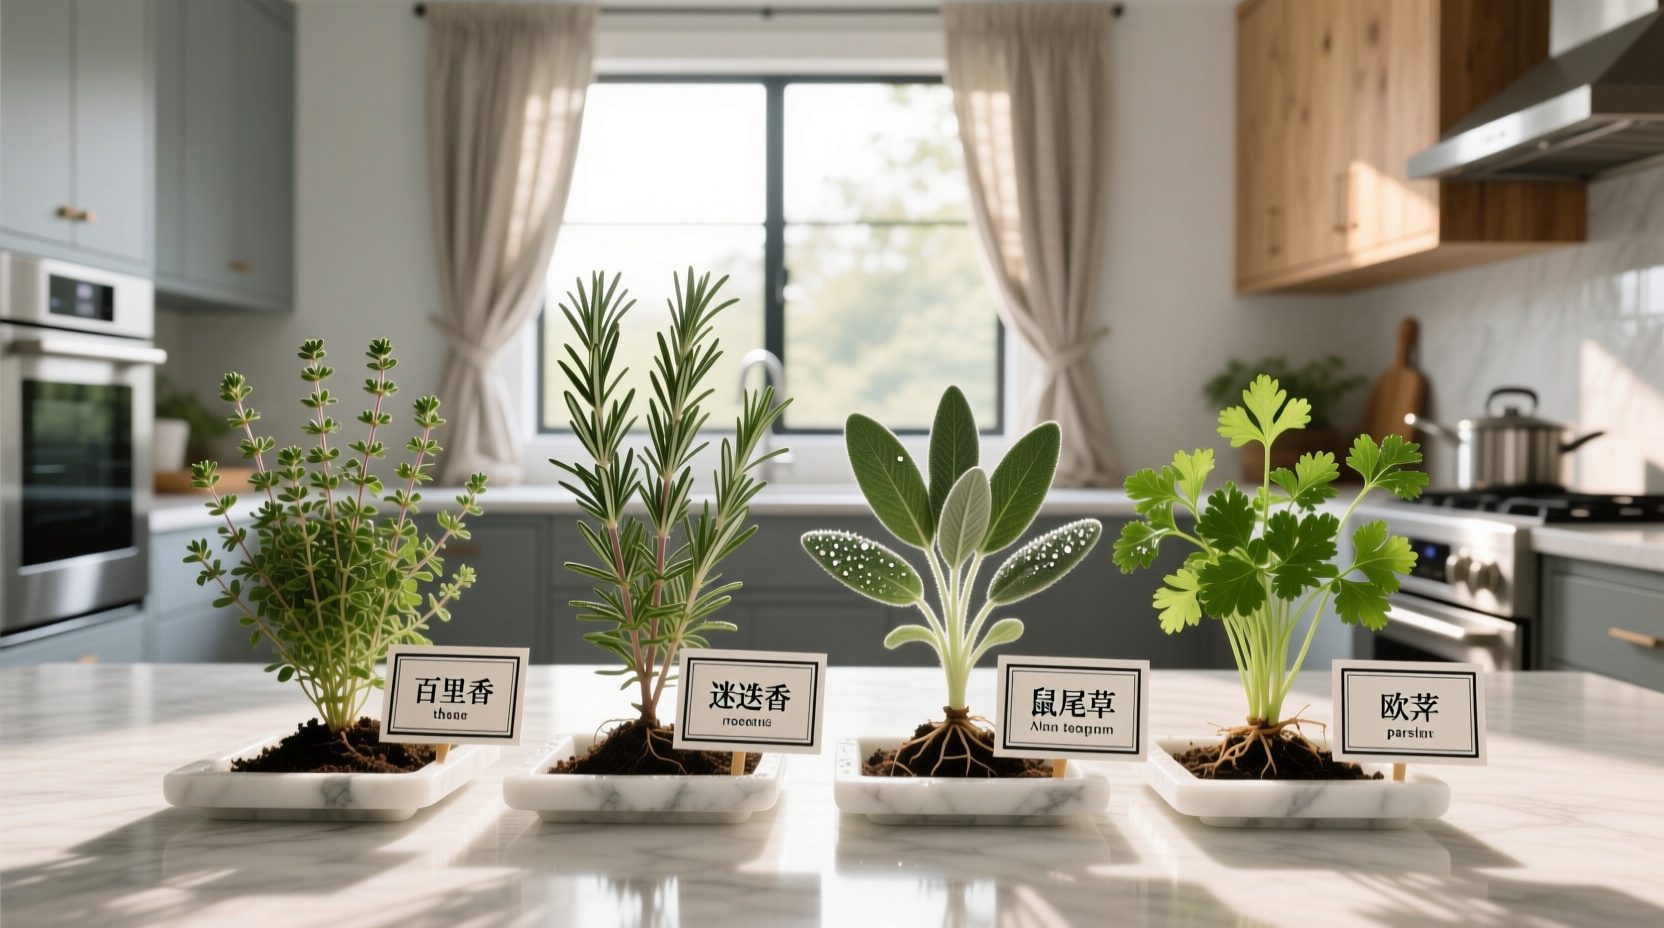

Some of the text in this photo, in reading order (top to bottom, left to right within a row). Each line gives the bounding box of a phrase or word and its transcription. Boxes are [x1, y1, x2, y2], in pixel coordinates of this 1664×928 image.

[415, 677, 494, 705] 百里香
[708, 680, 791, 712] 迷迭香
[1031, 687, 1116, 719] 鼠尾草
